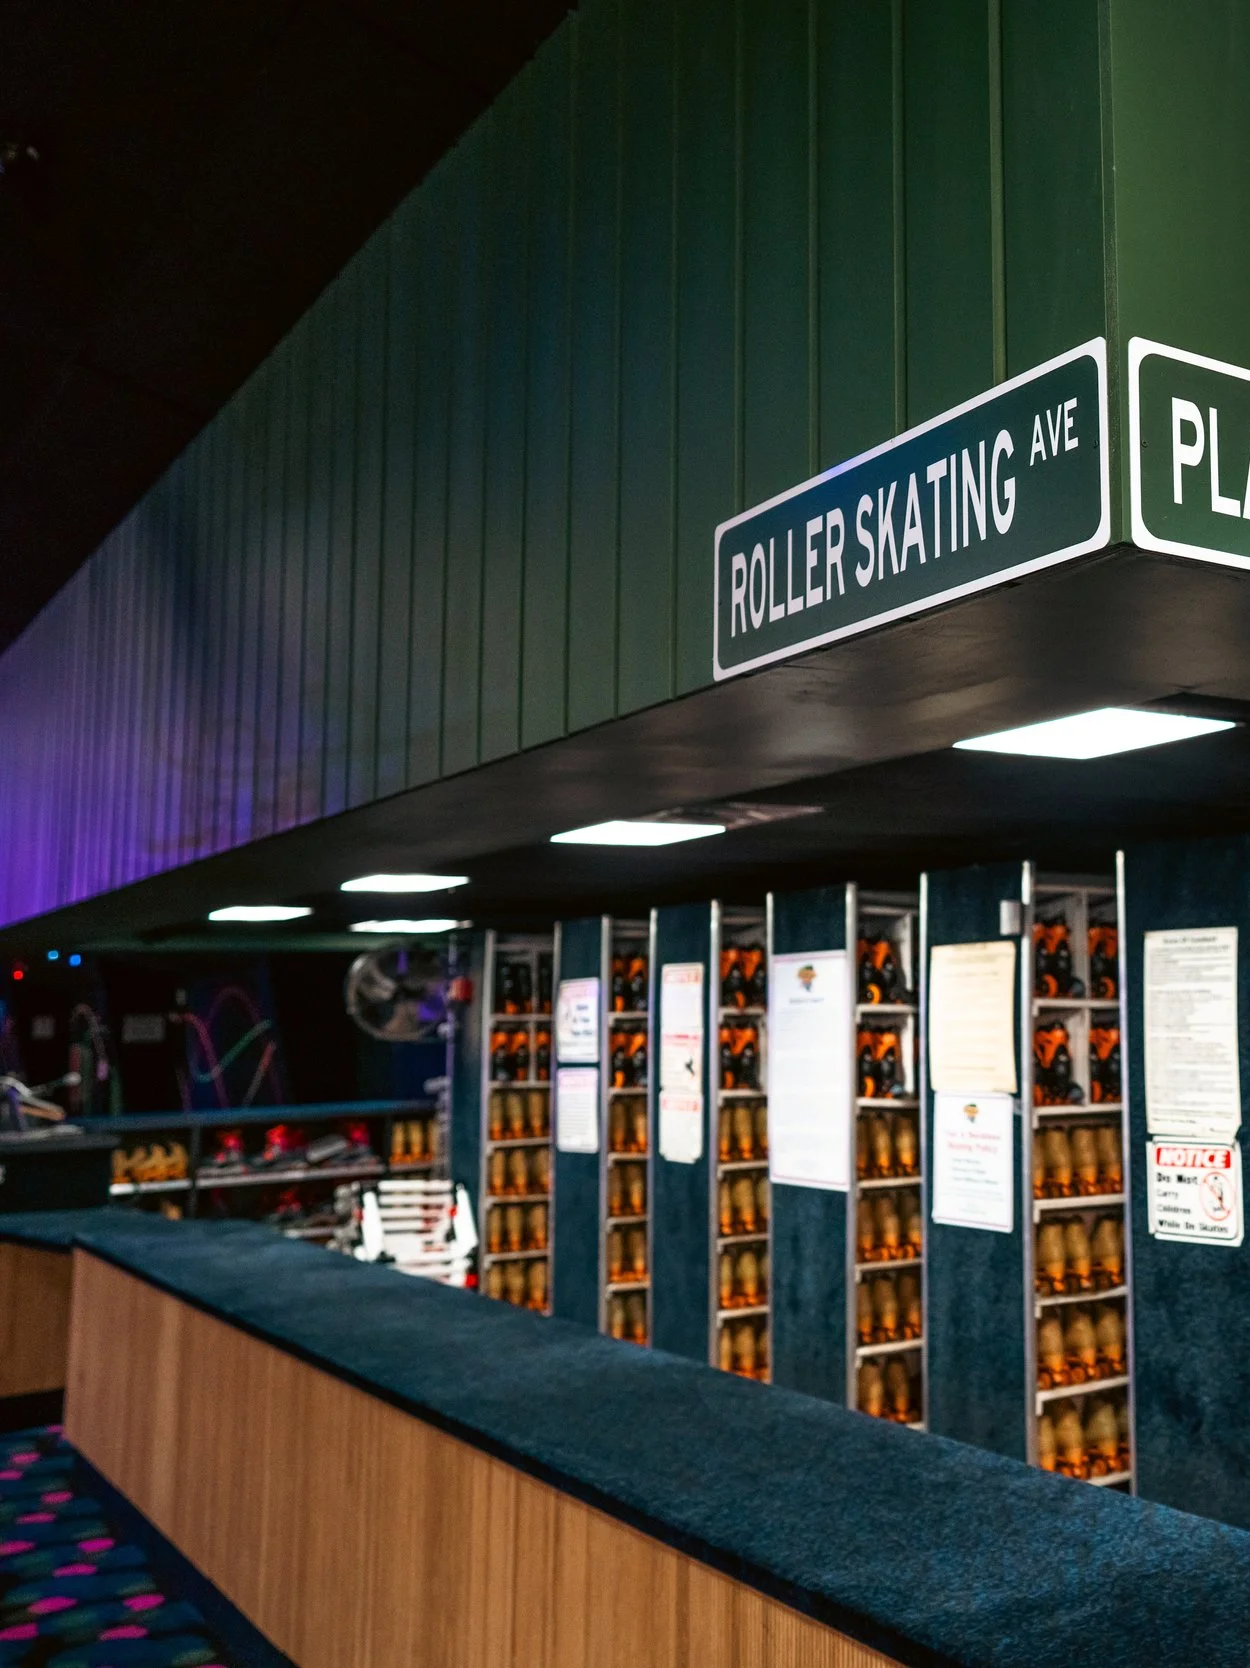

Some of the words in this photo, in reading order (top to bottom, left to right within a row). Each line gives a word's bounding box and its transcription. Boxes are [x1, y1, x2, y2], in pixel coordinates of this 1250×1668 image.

[730, 506, 848, 638] ROLLER
[855, 428, 1016, 588] SKATING
[1029, 397, 1079, 467] AVE
[1158, 1148, 1227, 1167] NOTICE
